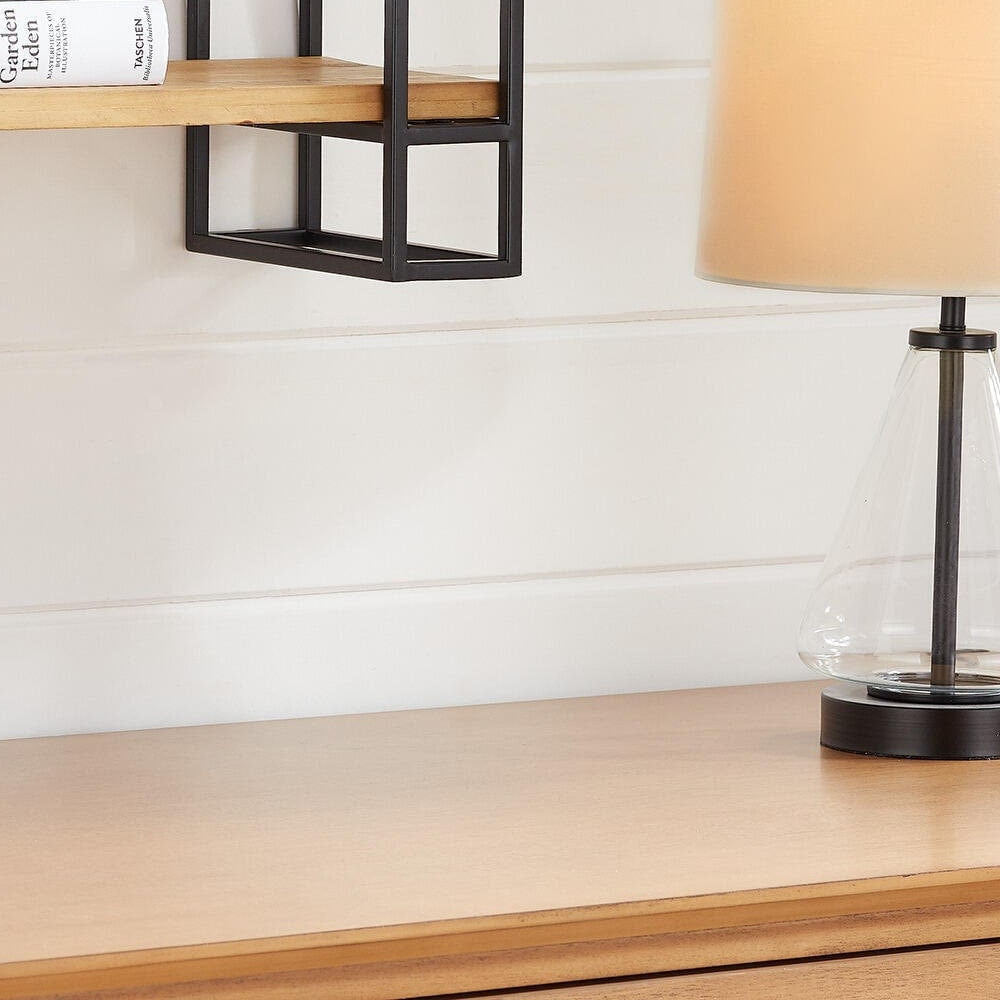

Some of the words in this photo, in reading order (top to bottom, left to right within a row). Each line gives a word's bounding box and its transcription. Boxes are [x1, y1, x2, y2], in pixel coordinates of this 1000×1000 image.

[0, 9, 18, 84] Garden
[21, 19, 40, 71] Eden
[46, 24, 55, 80] MASTERPIECES
[134, 18, 145, 69] TASCHEN
[142, 44, 153, 81] Bibliotheca
